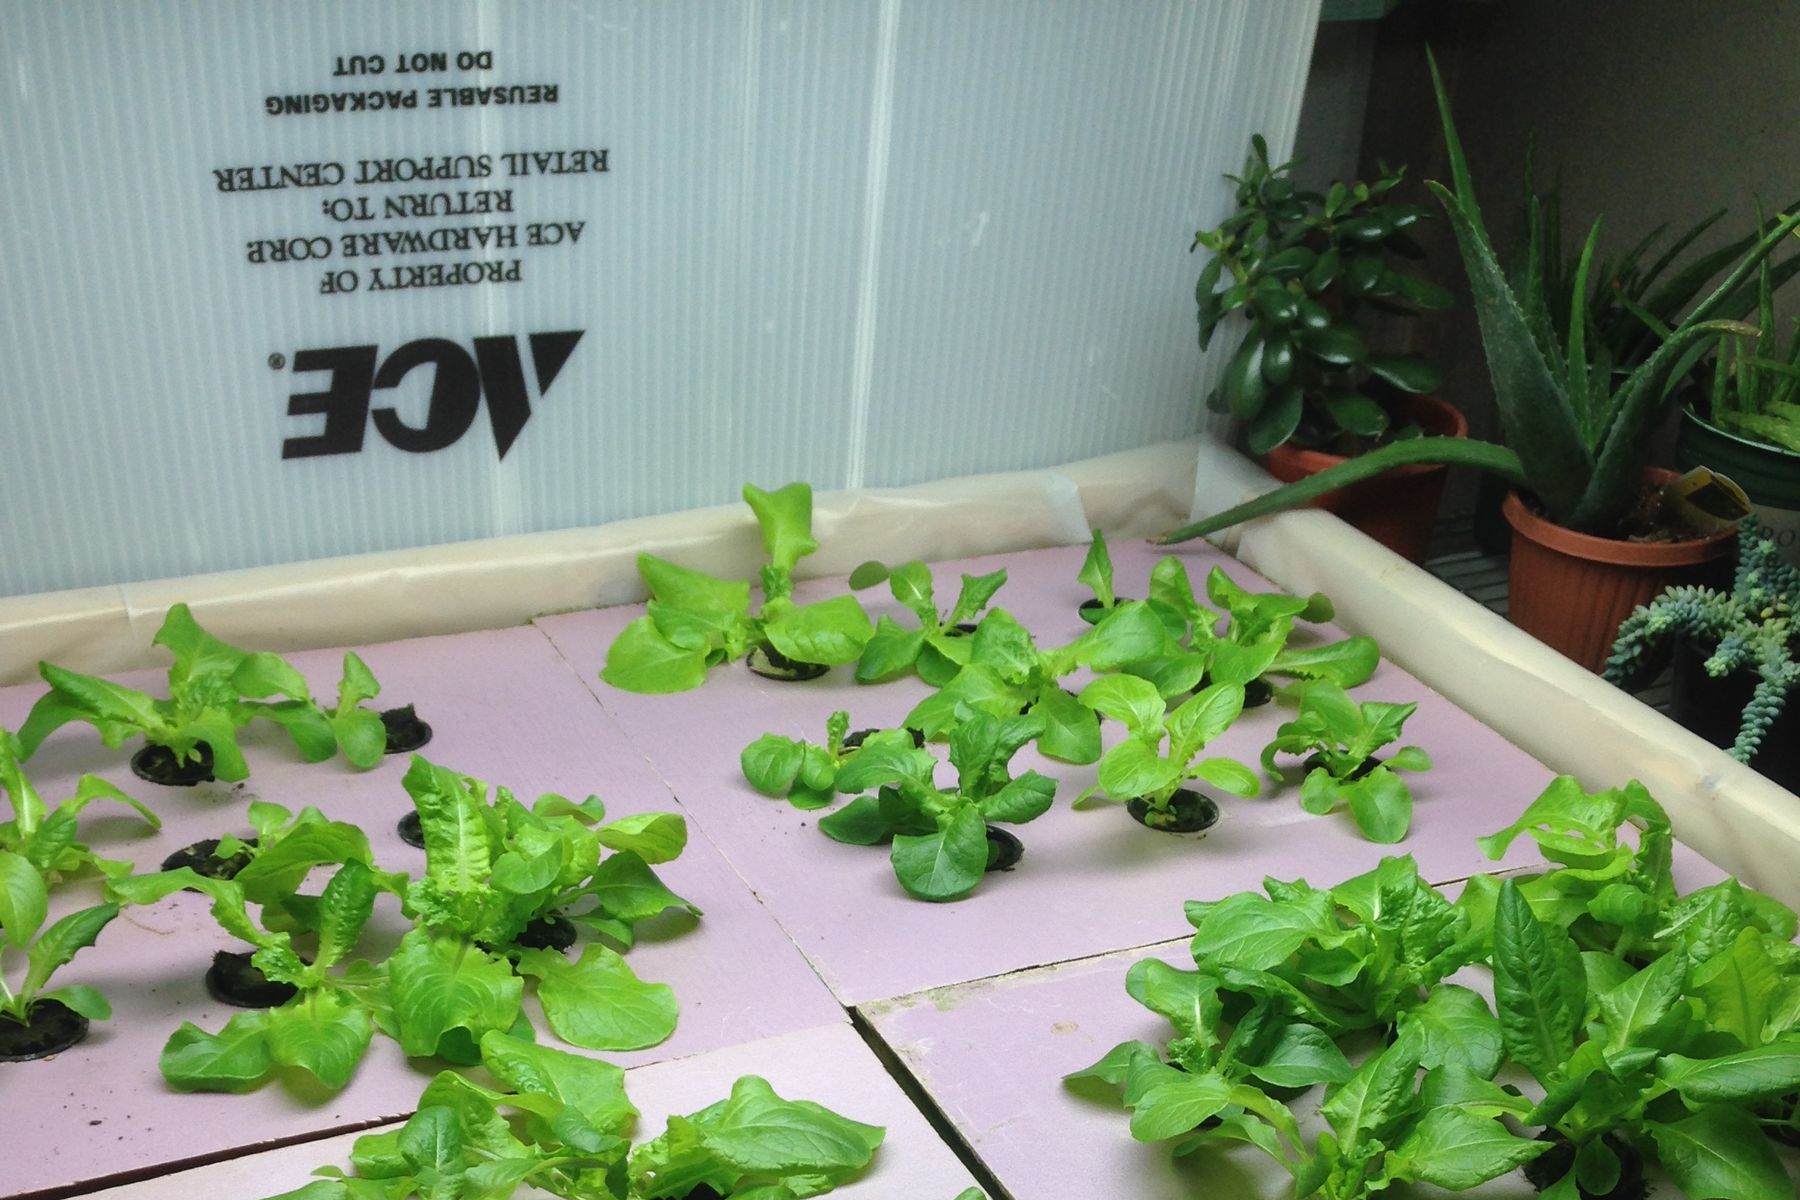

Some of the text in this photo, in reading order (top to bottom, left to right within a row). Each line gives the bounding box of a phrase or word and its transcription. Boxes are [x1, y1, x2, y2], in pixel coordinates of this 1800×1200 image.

[331, 50, 494, 78] DO NOT CUT
[263, 83, 561, 117] REUSABLE PACKAGING
[212, 147, 611, 194] RETAIL SUPPORT CENTER
[321, 188, 515, 223] RETURN TO:
[340, 224, 519, 258] HARDWARE
[526, 220, 587, 248] ACE
[318, 258, 524, 296] PROPERTY OF
